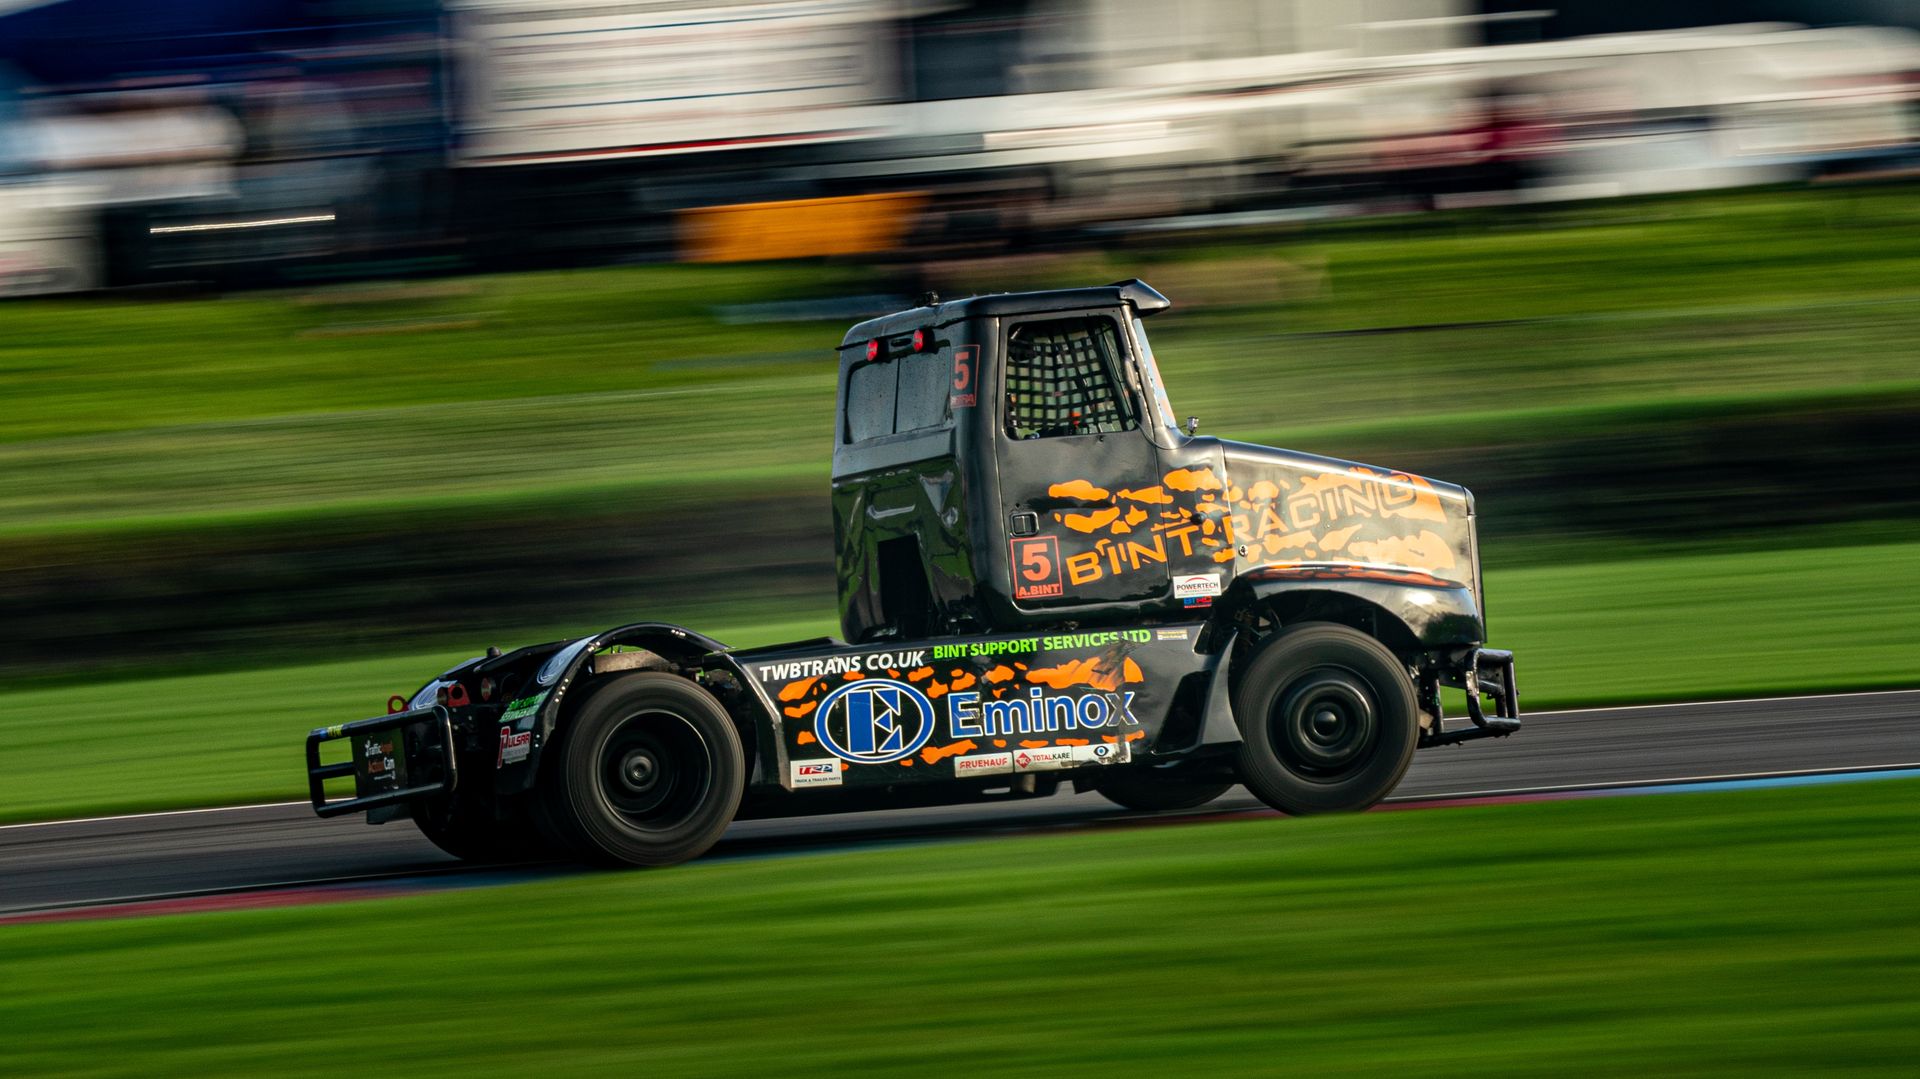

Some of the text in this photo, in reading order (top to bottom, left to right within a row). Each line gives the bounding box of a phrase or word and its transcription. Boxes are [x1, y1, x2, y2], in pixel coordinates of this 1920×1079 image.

[954, 351, 970, 390] 5
[1065, 473, 1417, 586] BINT RACING
[1022, 543, 1052, 582] 5
[1018, 583, 1060, 598] A.BINT
[1176, 582, 1219, 592] POWERTECH
[933, 643, 968, 659] BINT
[970, 637, 1040, 657] SUPPORT
[1043, 632, 1119, 651] SERVICES
[759, 650, 926, 682] TWBTRANS CO.UK
[947, 687, 1139, 738] Eminox
[958, 757, 1009, 770] FRUEHAUF
[1032, 752, 1071, 762] TOTALKARE
